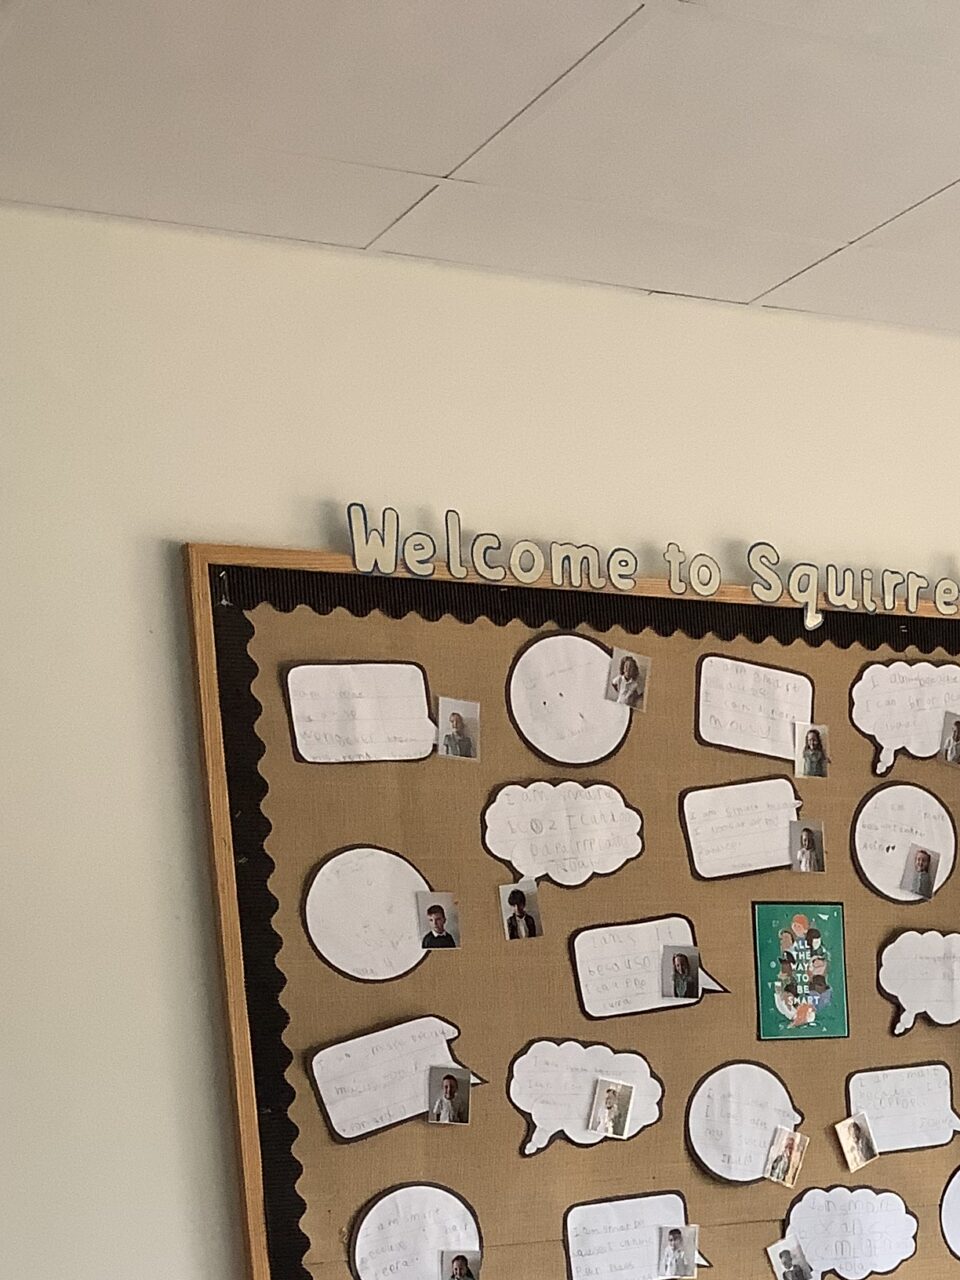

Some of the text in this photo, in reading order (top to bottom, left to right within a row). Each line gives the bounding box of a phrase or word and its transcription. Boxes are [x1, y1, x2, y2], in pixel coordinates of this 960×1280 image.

[347, 502, 638, 591] Welcome
[664, 542, 722, 597] to
[792, 940, 811, 949] ALL
[793, 951, 812, 960] THE
[790, 962, 814, 971] WAYS
[796, 973, 810, 982] TO
[797, 985, 810, 994] BE
[788, 996, 820, 1005] SMART
